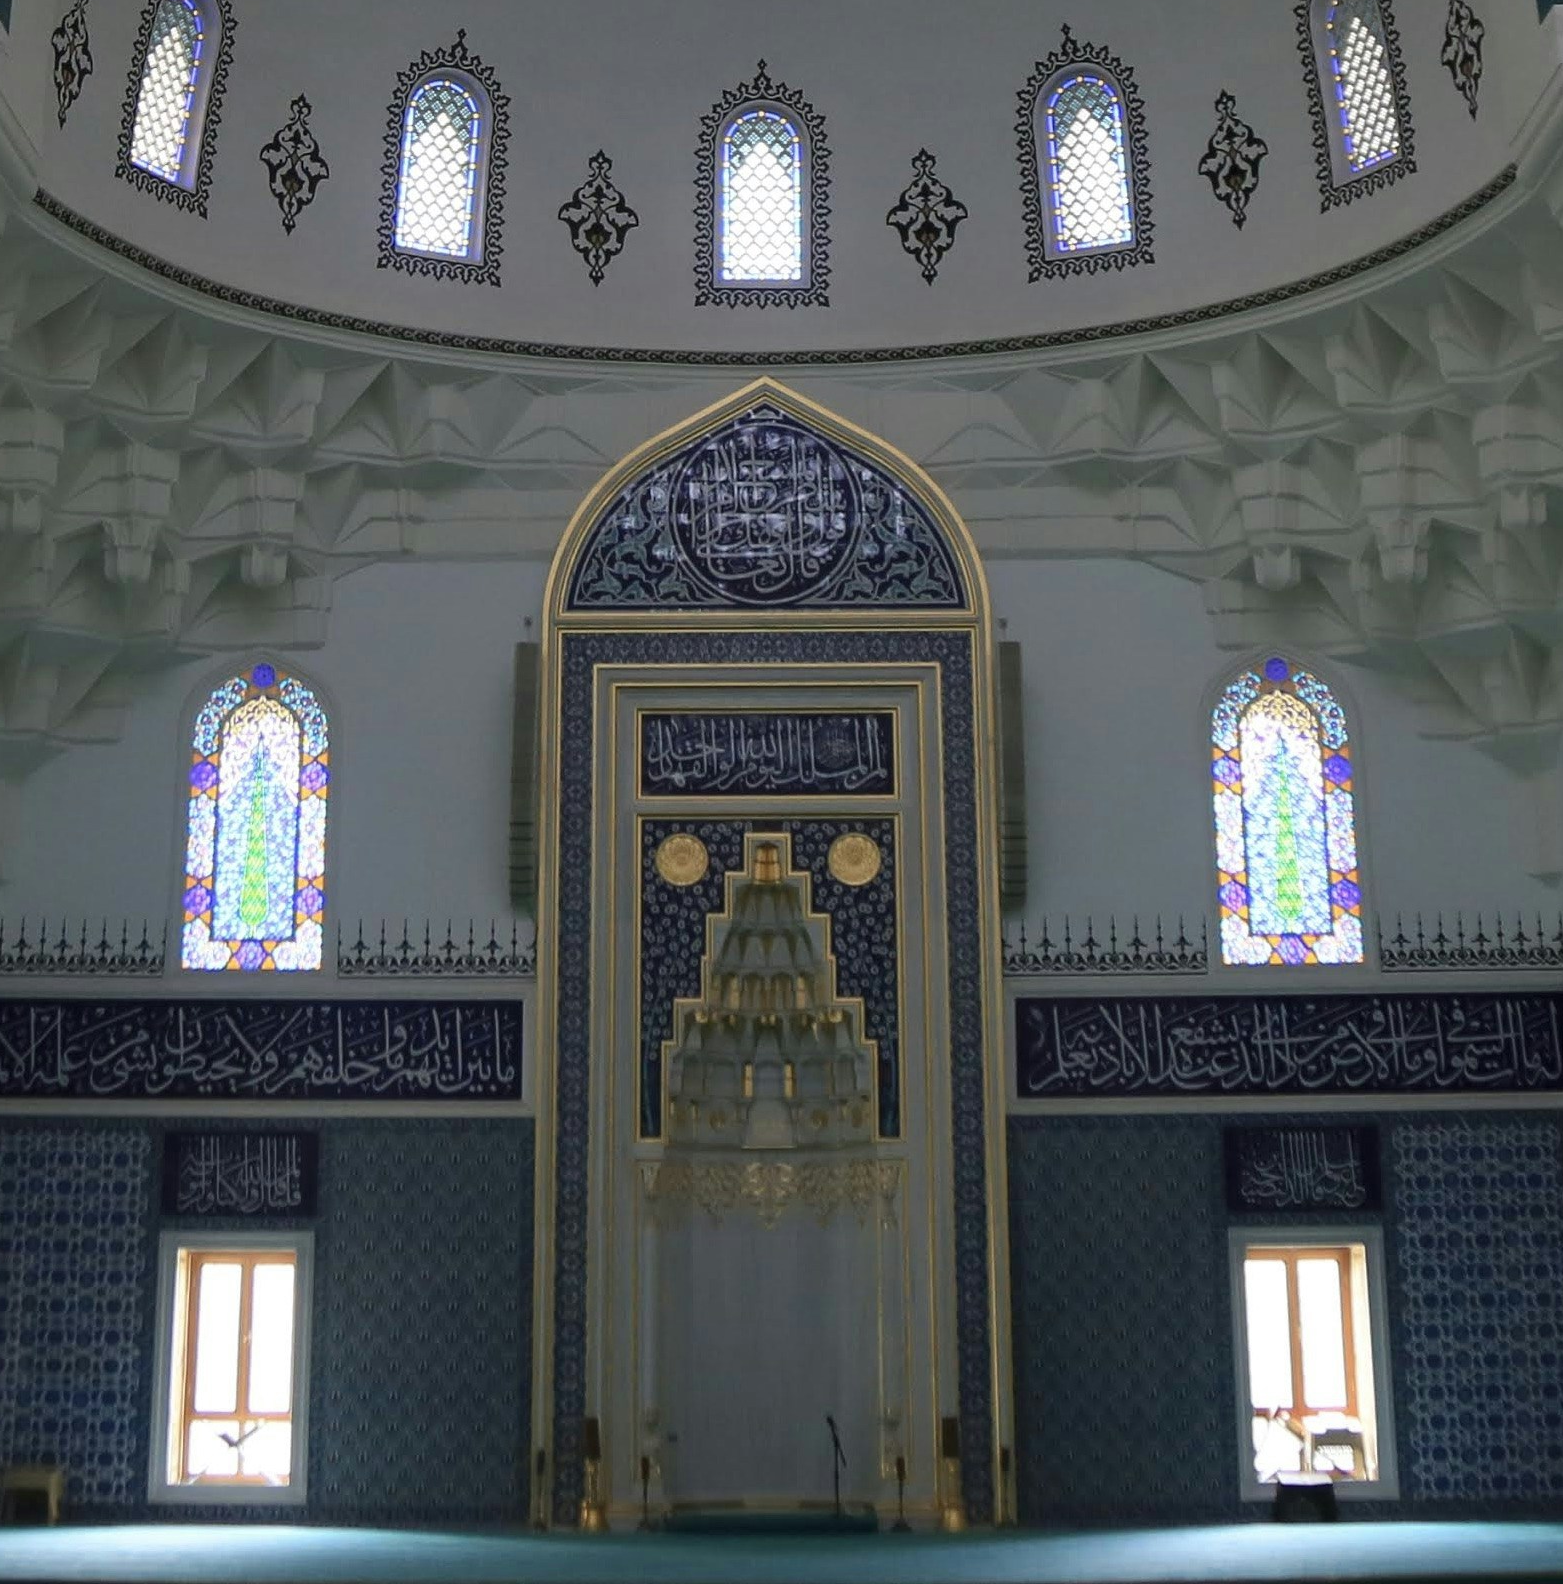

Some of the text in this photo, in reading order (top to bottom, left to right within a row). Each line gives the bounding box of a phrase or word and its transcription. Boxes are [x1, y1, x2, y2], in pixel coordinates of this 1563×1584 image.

[21, 1006, 88, 1090] علمه
[89, 1028, 150, 1066] من
[263, 1006, 380, 1094] خلفهم
[365, 1006, 408, 1071] وما
[492, 1006, 516, 1083] ما
